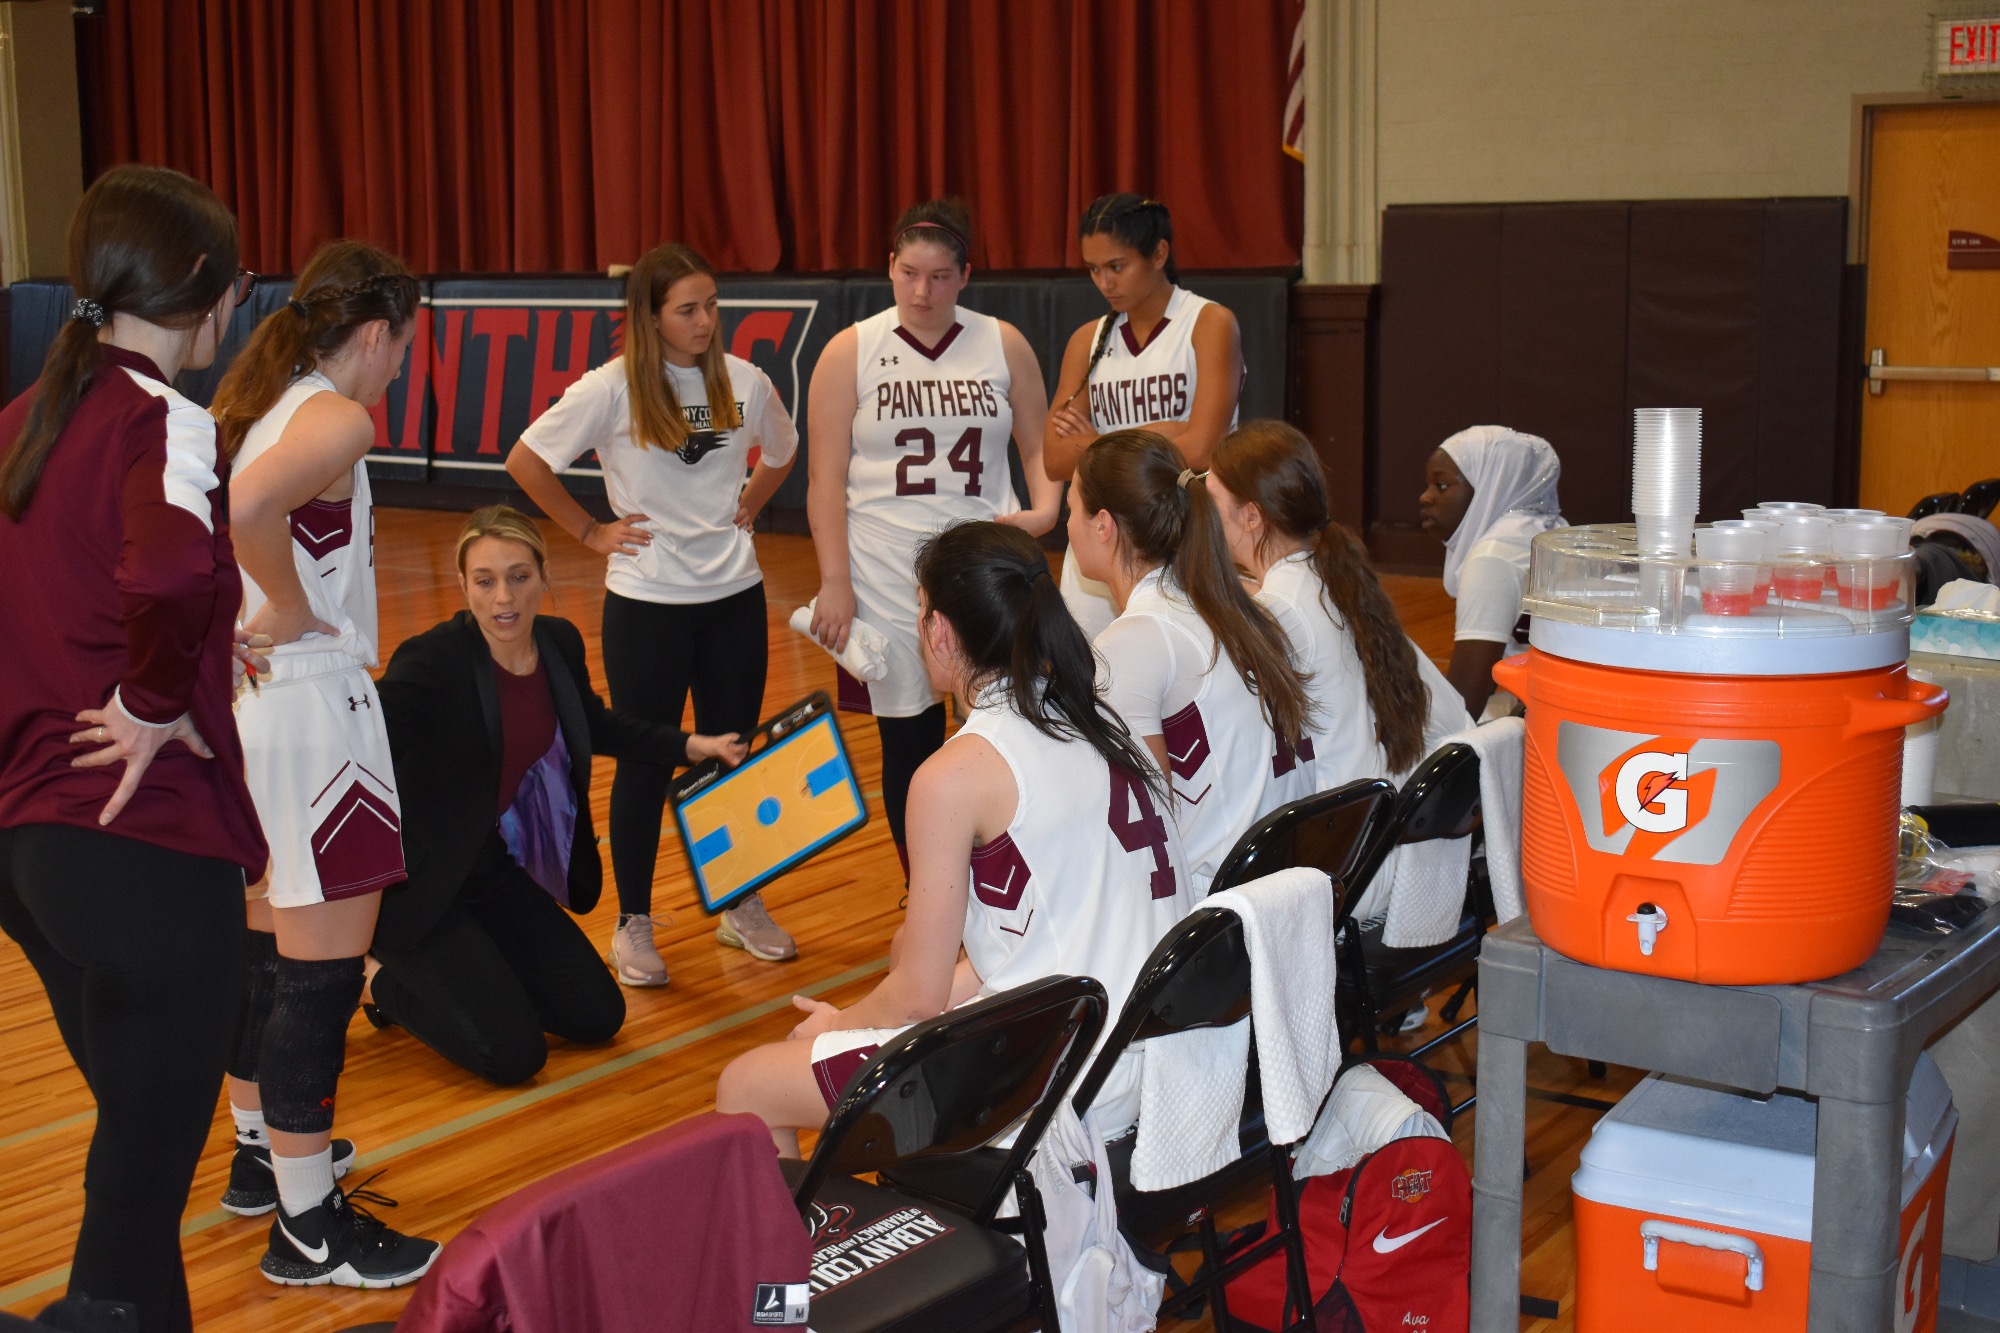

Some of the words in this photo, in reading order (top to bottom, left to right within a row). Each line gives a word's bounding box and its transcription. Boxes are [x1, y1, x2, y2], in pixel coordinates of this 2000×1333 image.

[1951, 24, 2000, 65] EXIT
[877, 379, 999, 421] PANTHERS
[1090, 372, 1188, 428] PANTHERS
[894, 426, 984, 498] 24
[1615, 751, 1689, 834] G
[1391, 1170, 1432, 1201] HEAT
[838, 1238, 858, 1250] AND
[849, 1214, 948, 1269] ALBANY
[851, 1210, 916, 1244] PHARMACY
[809, 1257, 863, 1297] COLL
[795, 1307, 804, 1319] M
[1402, 1311, 1430, 1326] Ava
